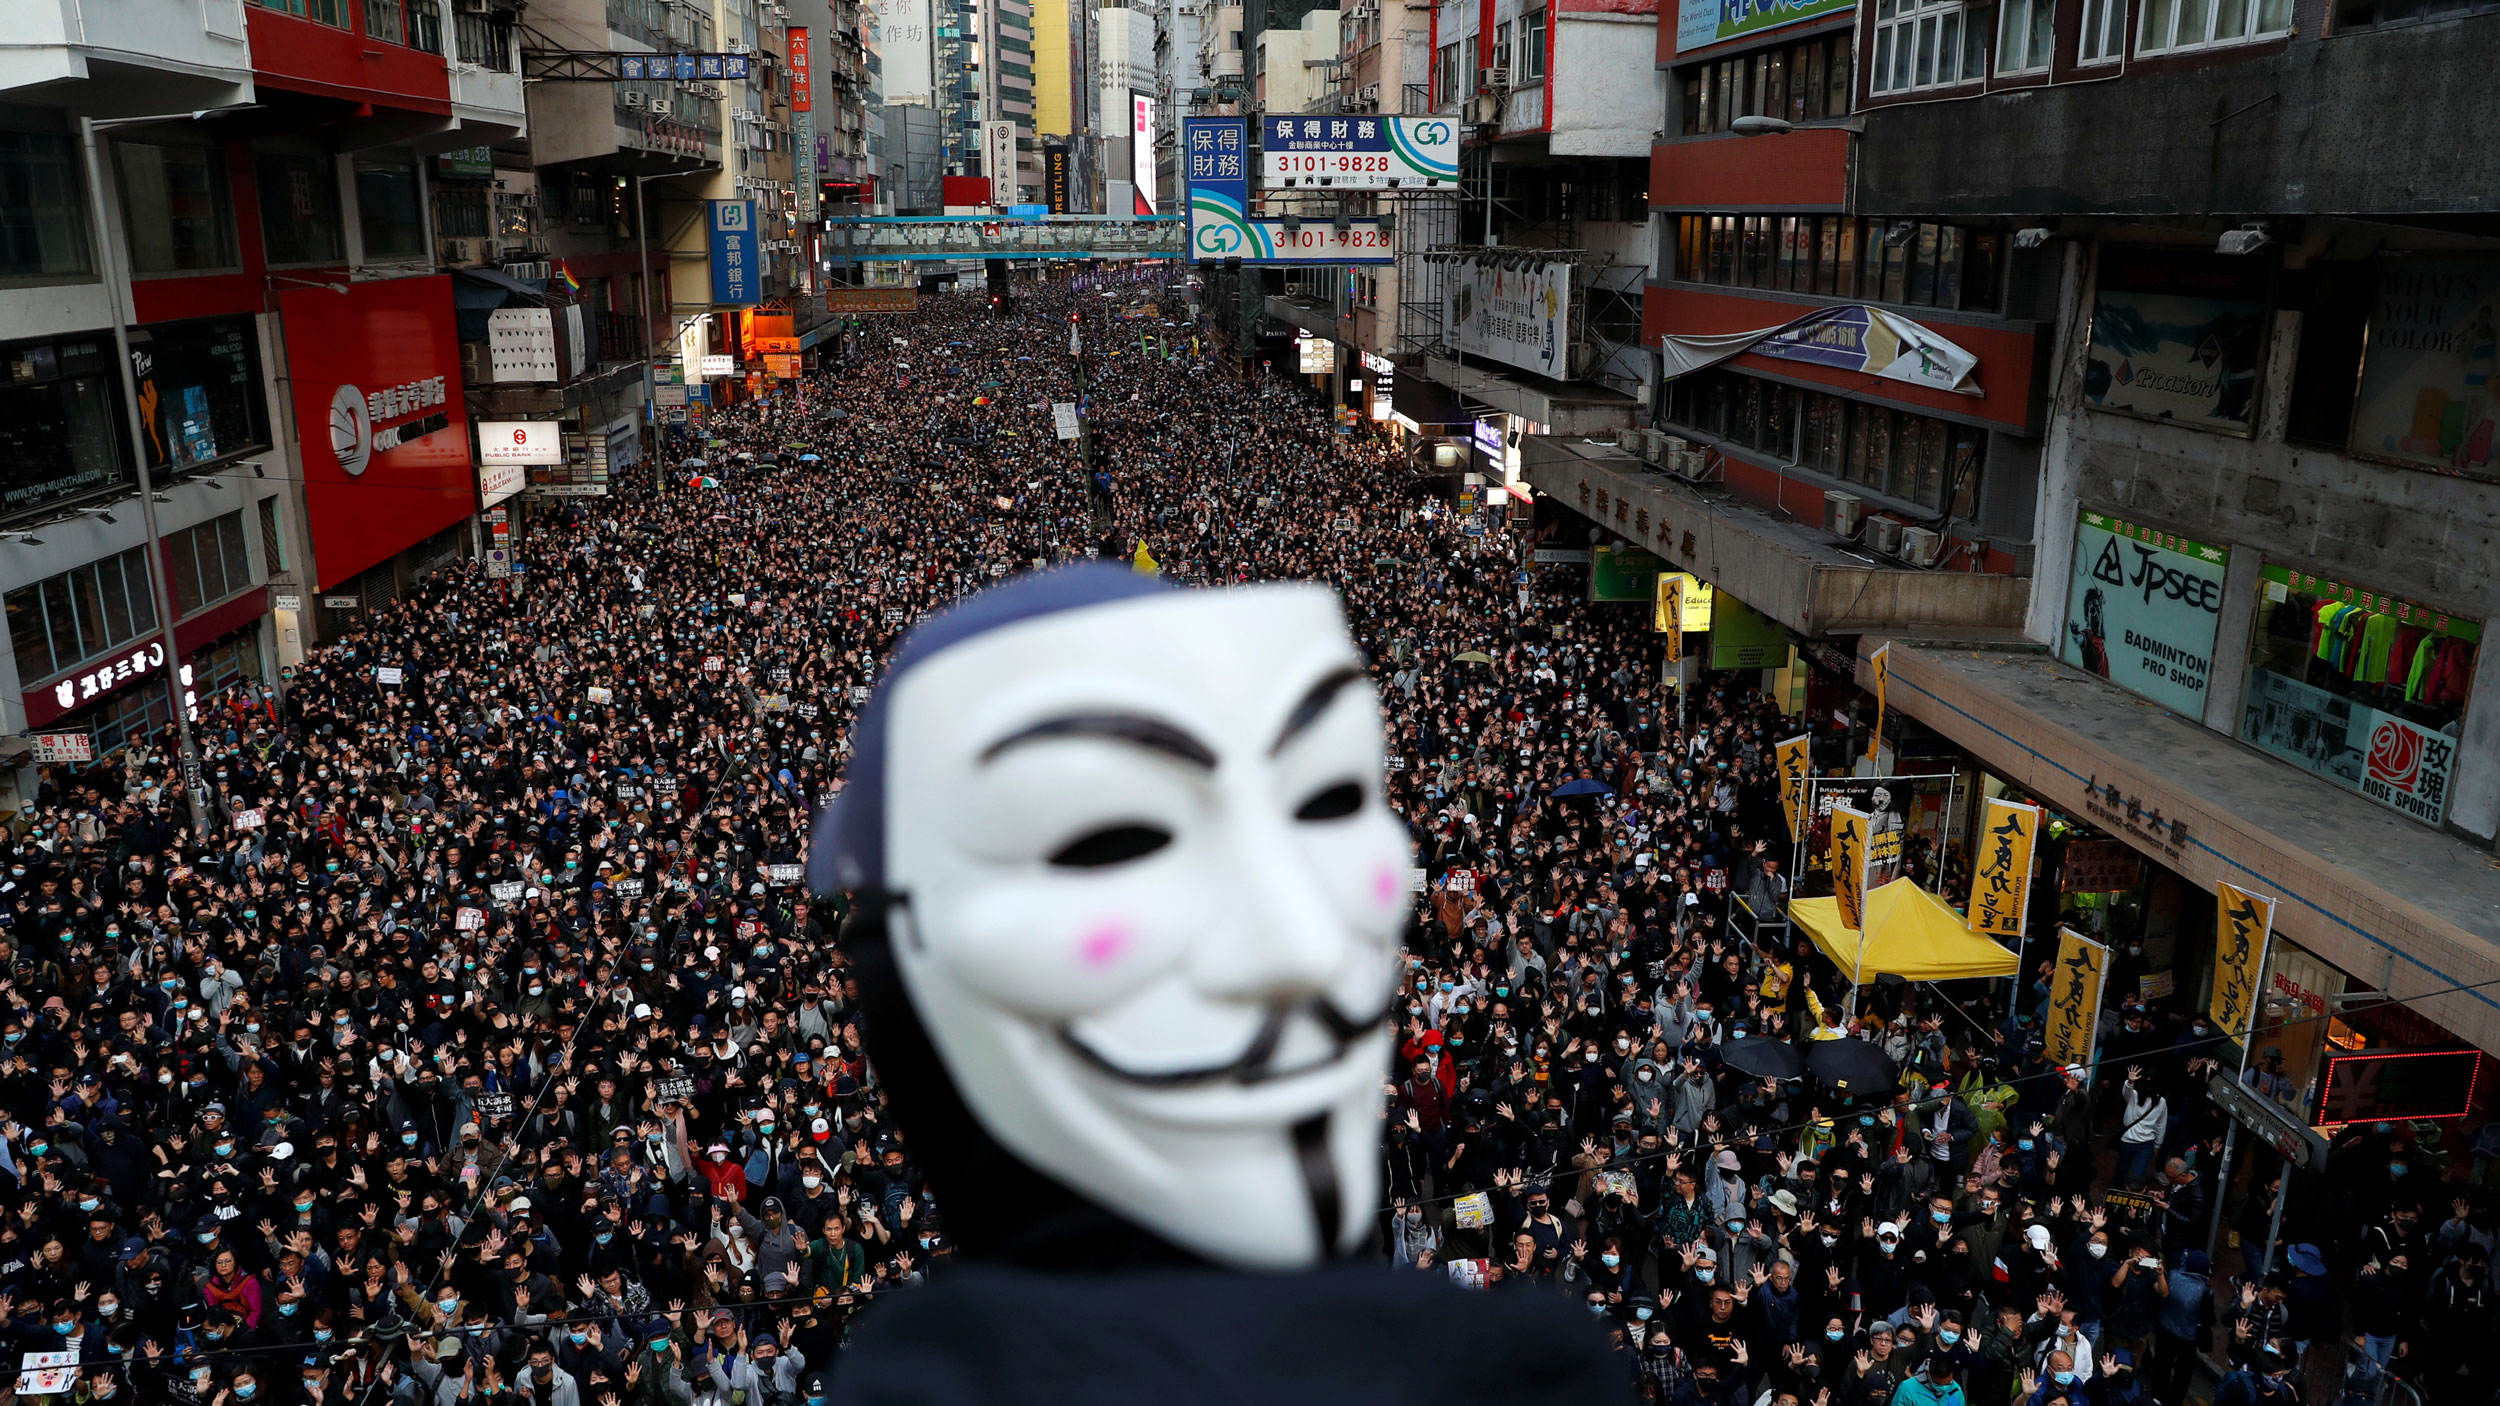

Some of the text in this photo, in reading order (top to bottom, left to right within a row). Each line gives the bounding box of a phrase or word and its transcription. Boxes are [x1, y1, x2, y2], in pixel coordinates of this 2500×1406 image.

[1689, 10, 1703, 22] World
[1703, 8, 1715, 18] Class
[886, 24, 923, 43] 作坊
[1678, 22, 1715, 40] Outdoor Products
[792, 36, 807, 103] 六福珠寶
[1276, 120, 1376, 139] 保得財務
[1192, 129, 1238, 151] 保得
[1288, 140, 1354, 150] 金聯商業中心十樓
[1000, 142, 1008, 193] 中國銀行
[1193, 154, 1240, 177] 財務
[1278, 156, 1389, 172] 3101-9828
[800, 161, 811, 218] JEWELLERY
[1376, 176, 1426, 185] 特人貸款
[1274, 230, 1391, 248] 3101-9828
[725, 234, 744, 300] 富邦銀行
[2384, 271, 2480, 300] WHAT'S
[2384, 301, 2442, 326] YOUR
[1838, 326, 1857, 348] 1616
[2378, 327, 2467, 354] COLOR?
[23, 350, 42, 363] TRIAL
[228, 342, 244, 353] YOGA
[230, 373, 249, 384] DANCE
[501, 476, 512, 488] BANK
[2141, 527, 2189, 554] 運動用品
[2288, 570, 2316, 593] 旅行
[2124, 629, 2208, 675] BADMINTON
[2142, 656, 2204, 692] PRO SHOP
[40, 735, 90, 747] 鄉下佬
[653, 777, 678, 785] 五大訴求
[2417, 737, 2452, 806] 玫瑰
[2362, 777, 2440, 824] ROSE SPORTS
[495, 885, 523, 894] 五大訴求
[616, 881, 642, 890] 五大訴求
[658, 1080, 694, 1091] 五大訴求
[477, 1096, 512, 1107] 五大訴求
[477, 1103, 513, 1114] 缺一不可
[2265, 1114, 2285, 1135] Road
[20, 1372, 74, 1392] H K
[167, 1378, 198, 1394] 五大訴
